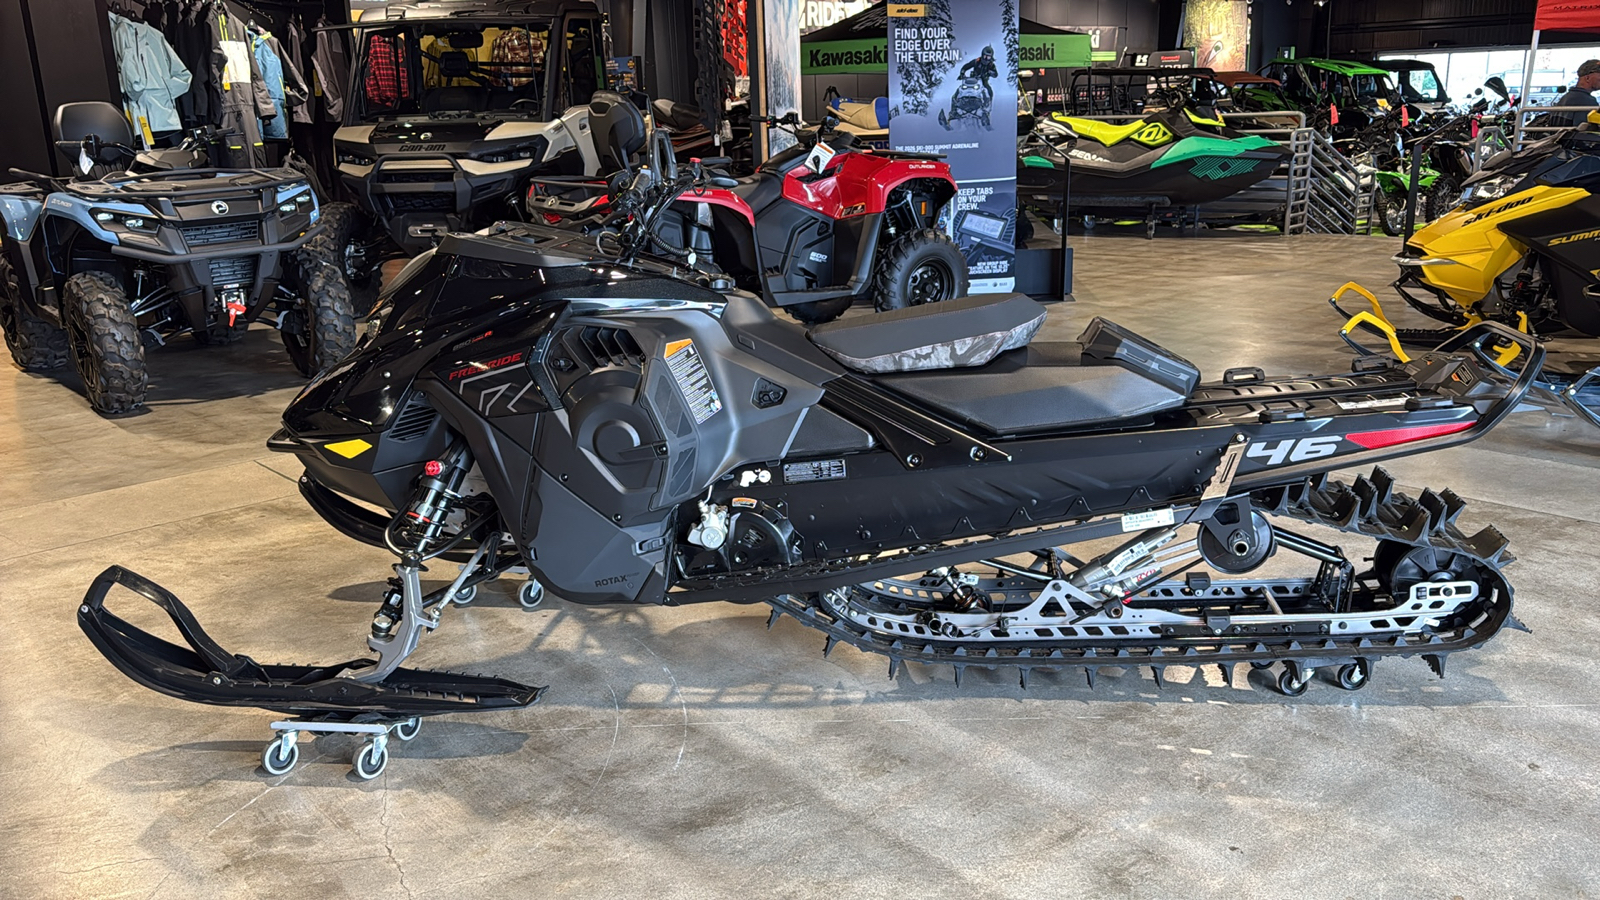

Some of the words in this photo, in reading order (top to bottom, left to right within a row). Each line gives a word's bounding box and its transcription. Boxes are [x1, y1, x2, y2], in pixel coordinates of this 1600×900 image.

[894, 28, 918, 39] FIND
[920, 27, 947, 39] YOUR
[895, 40, 921, 51] EDGE
[923, 39, 950, 50] OVER
[809, 45, 888, 67] Kawasaki
[895, 51, 914, 62] THE
[917, 49, 962, 61] TERRAIN.
[1019, 43, 1054, 61] asaki
[957, 188, 975, 196] KEEP
[976, 187, 993, 195] TABS
[957, 196, 967, 204] ON
[969, 195, 986, 203] YOUR
[957, 203, 979, 211] CREW.
[1461, 196, 1534, 228] ski-doo
[594, 574, 628, 587] ROTAX
